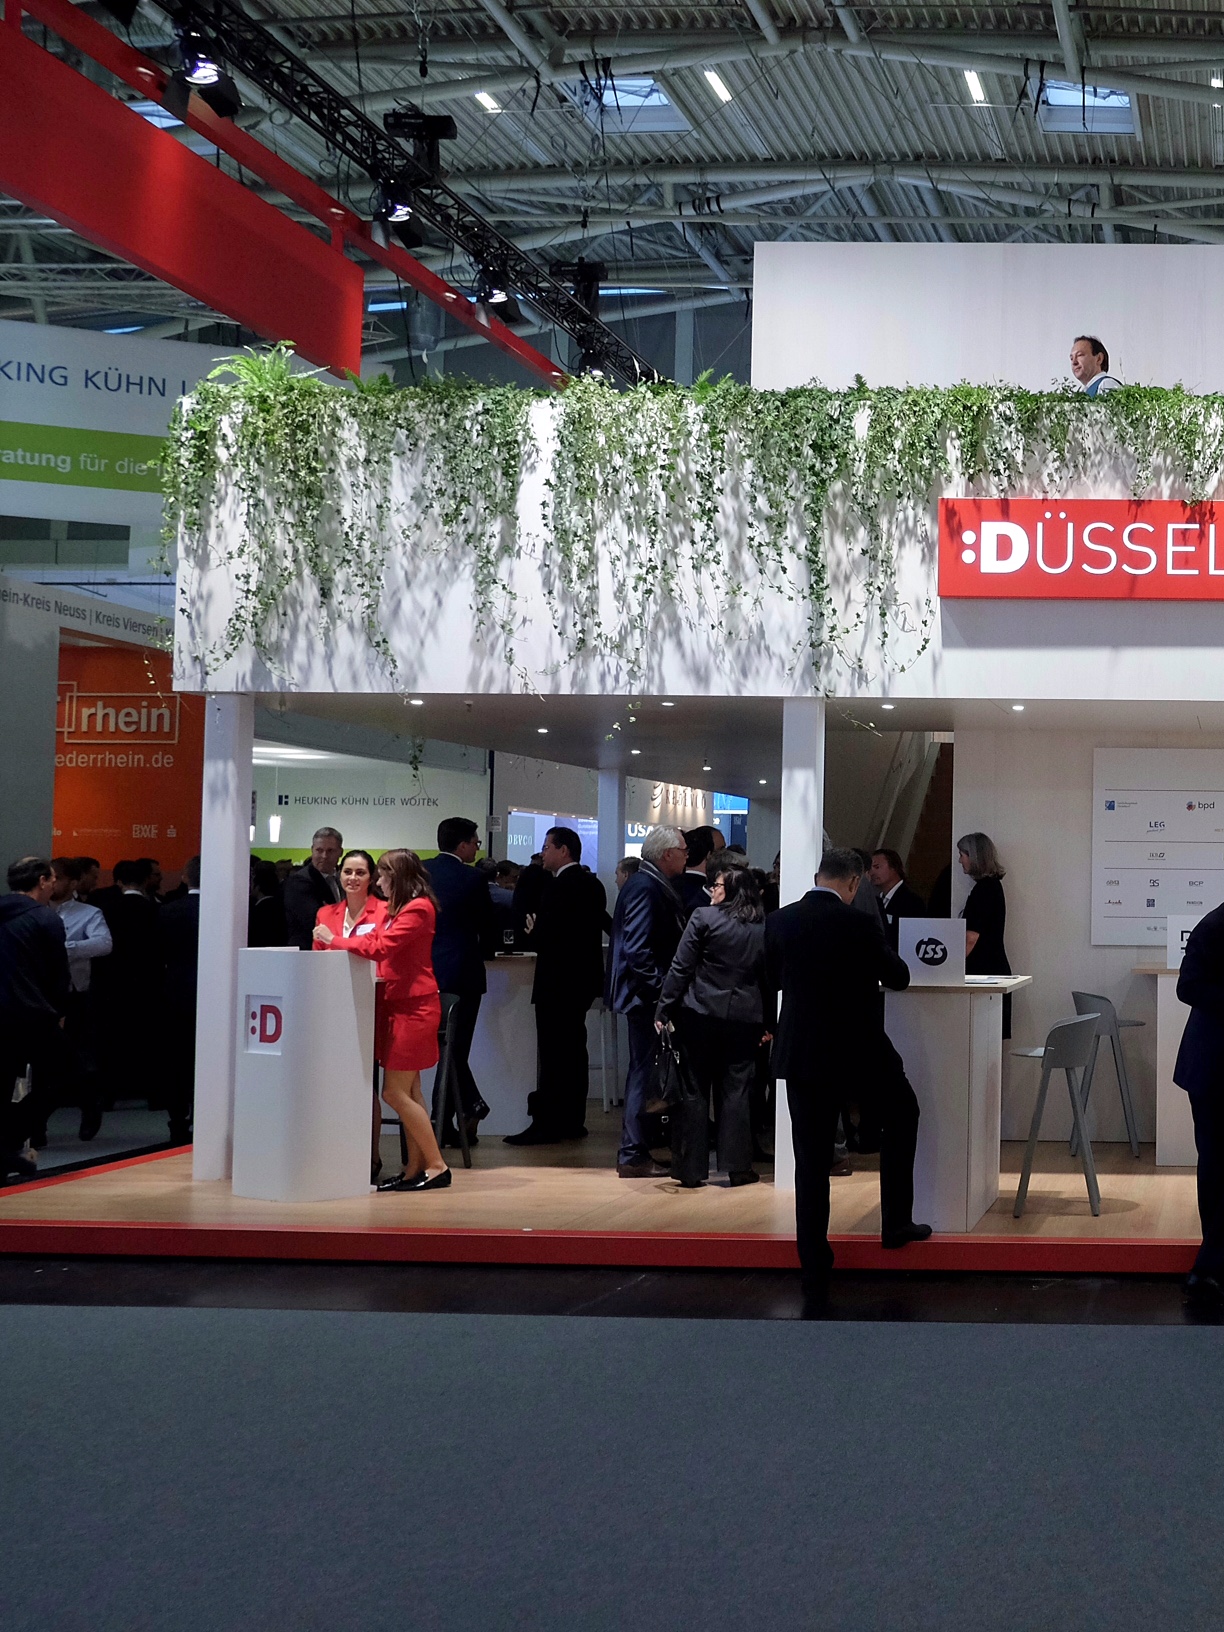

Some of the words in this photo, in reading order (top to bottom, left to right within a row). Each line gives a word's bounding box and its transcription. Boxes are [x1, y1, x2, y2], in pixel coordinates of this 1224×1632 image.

[84, 366, 166, 397] KÜHN
[79, 453, 109, 472] für
[115, 457, 148, 476] die
[54, 600, 87, 621] Neuss
[95, 611, 121, 628] Kreis
[123, 617, 158, 637] Viersen
[81, 701, 171, 733] rhein
[294, 796, 337, 806] HEUKING
[341, 795, 369, 806] KÜHN
[373, 795, 396, 806] LÜER
[400, 797, 439, 807] WOJTEK
[1197, 801, 1215, 811] bpd
